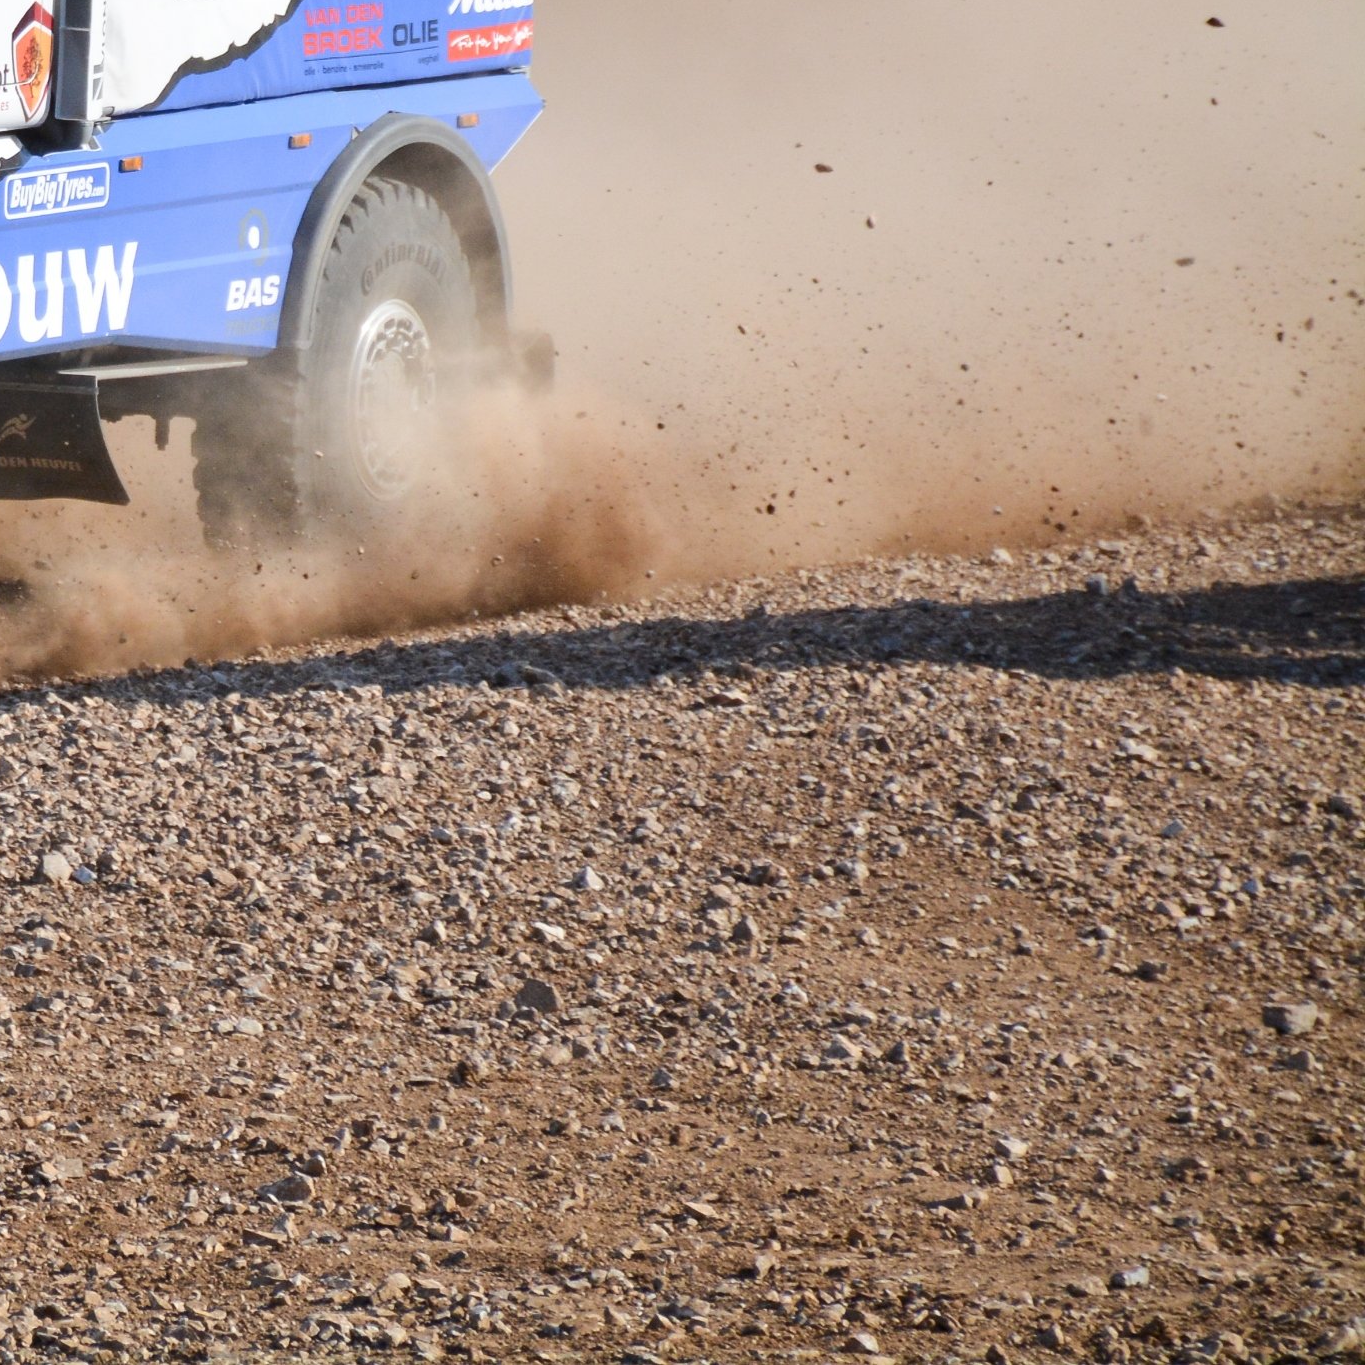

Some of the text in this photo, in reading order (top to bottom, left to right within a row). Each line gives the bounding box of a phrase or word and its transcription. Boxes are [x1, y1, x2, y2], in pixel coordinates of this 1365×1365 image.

[305, 2, 384, 27] VAN DEN
[303, 18, 439, 56] BROEK OLIE
[9, 172, 105, 213] BuyBigTyres.com
[225, 274, 281, 312] BAS
[31, 457, 84, 472] HEUVEL
